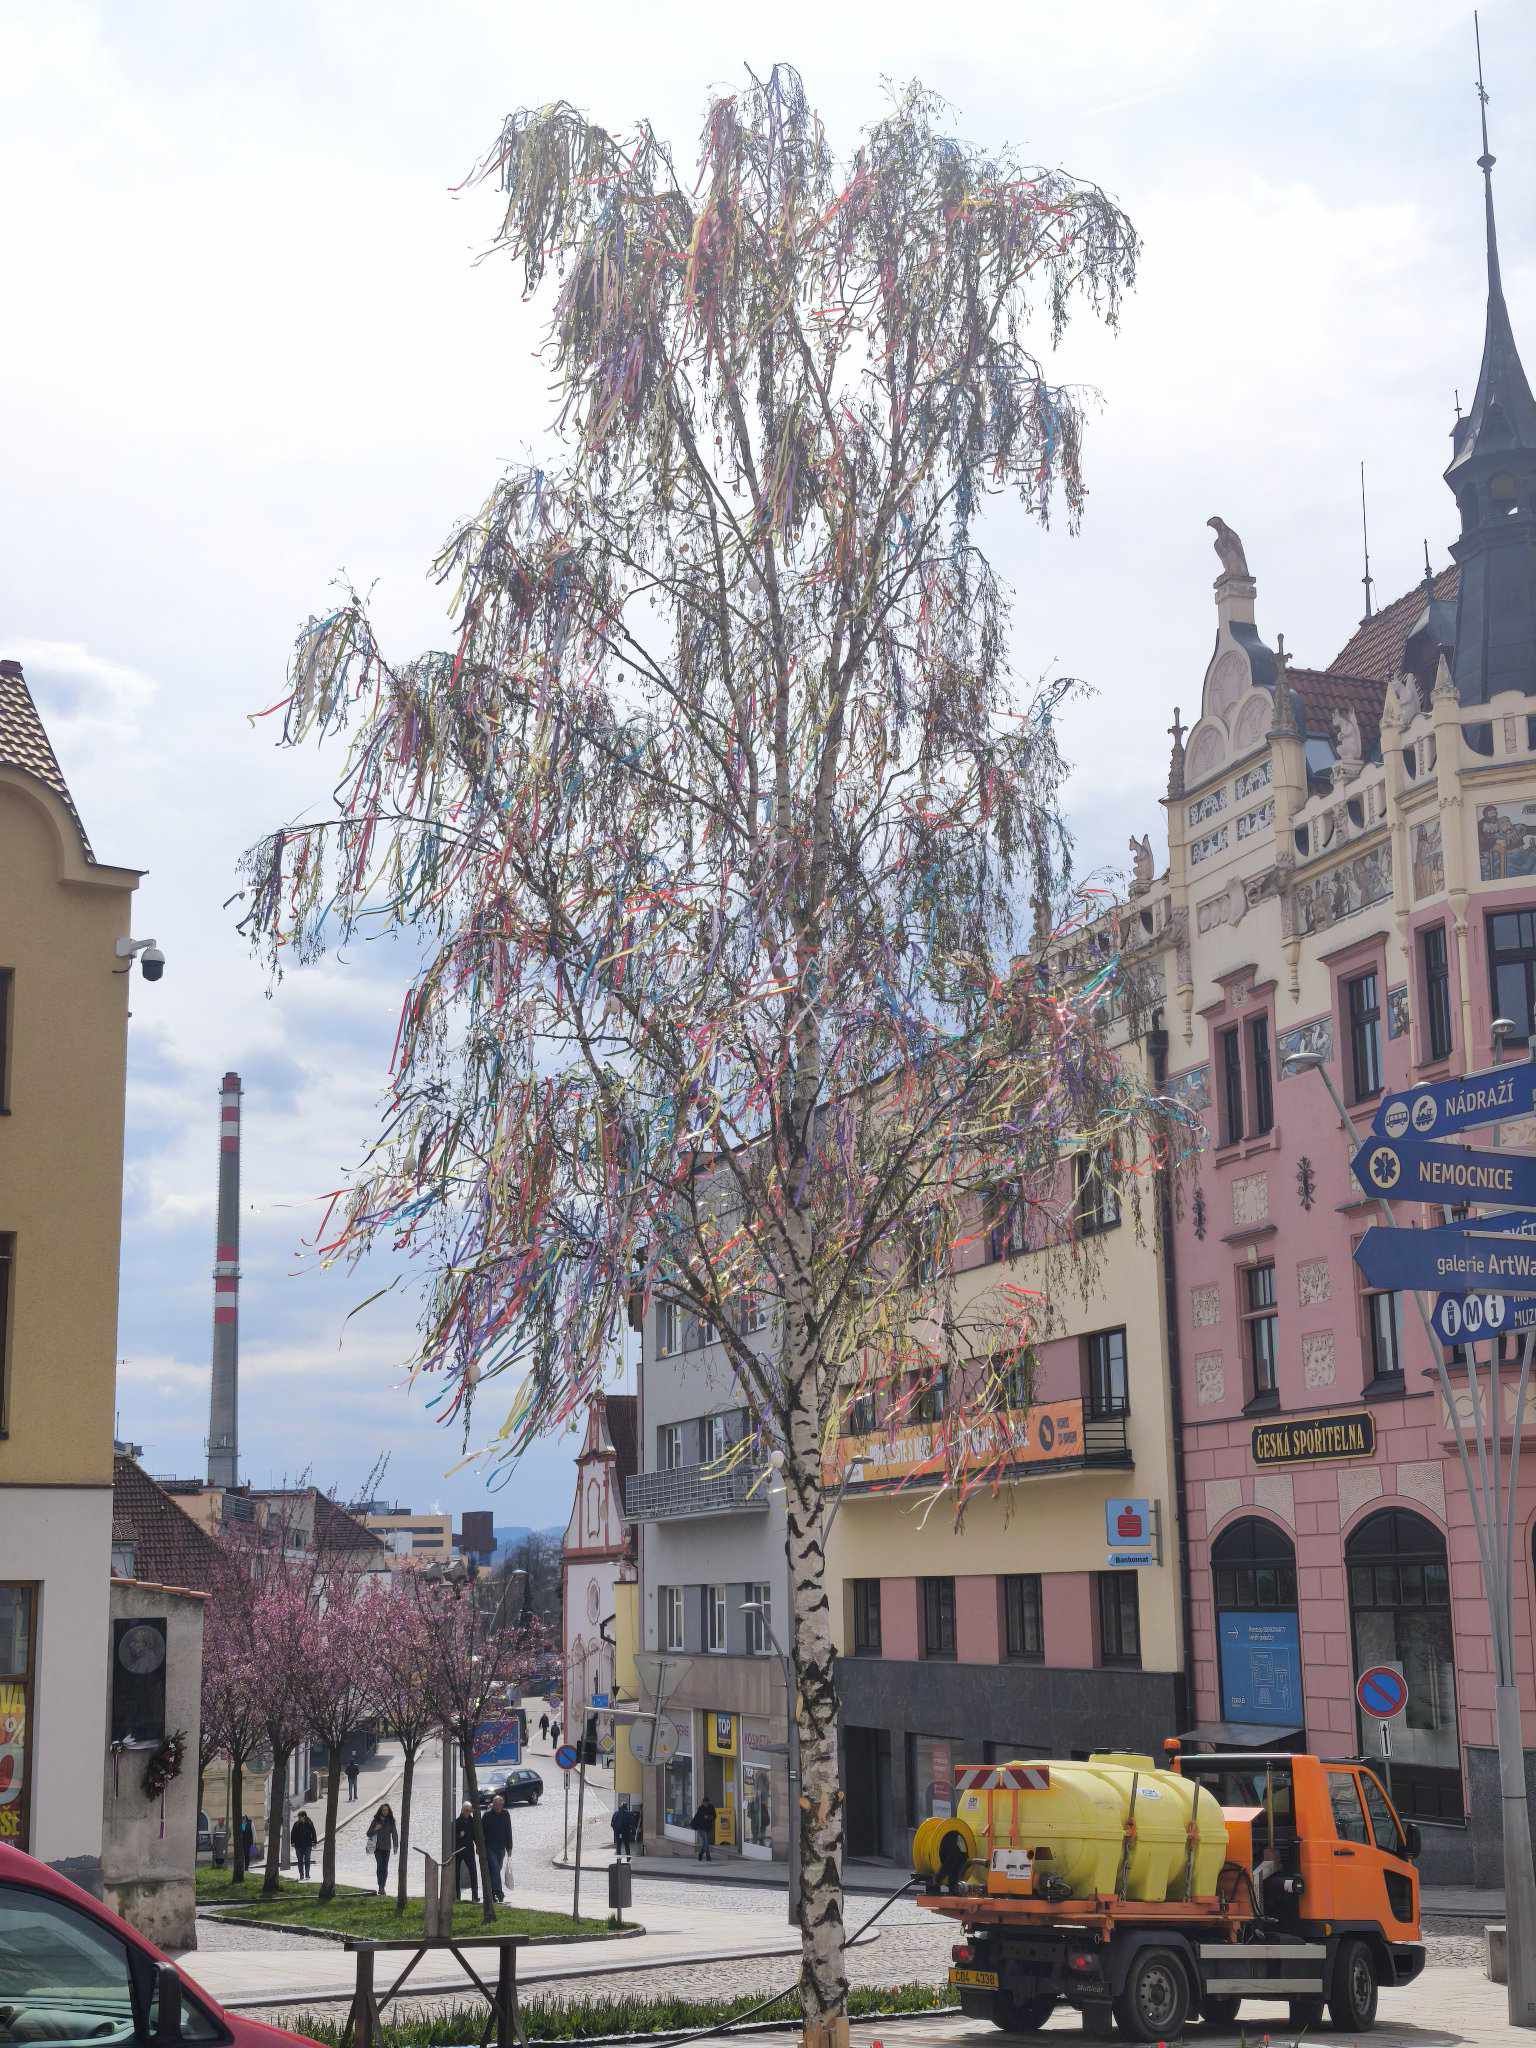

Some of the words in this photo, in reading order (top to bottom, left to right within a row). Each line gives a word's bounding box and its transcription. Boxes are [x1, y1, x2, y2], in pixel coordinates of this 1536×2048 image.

[1446, 1077, 1514, 1117] NÁDRAŽÍ
[1419, 1161, 1513, 1190] NEMOCNICE
[1437, 1255, 1485, 1275] galerie
[1514, 1308, 1536, 1328] MUZ
[1257, 1425, 1291, 1459] ČESKÁ
[1293, 1420, 1364, 1455] SPOŘITELNA
